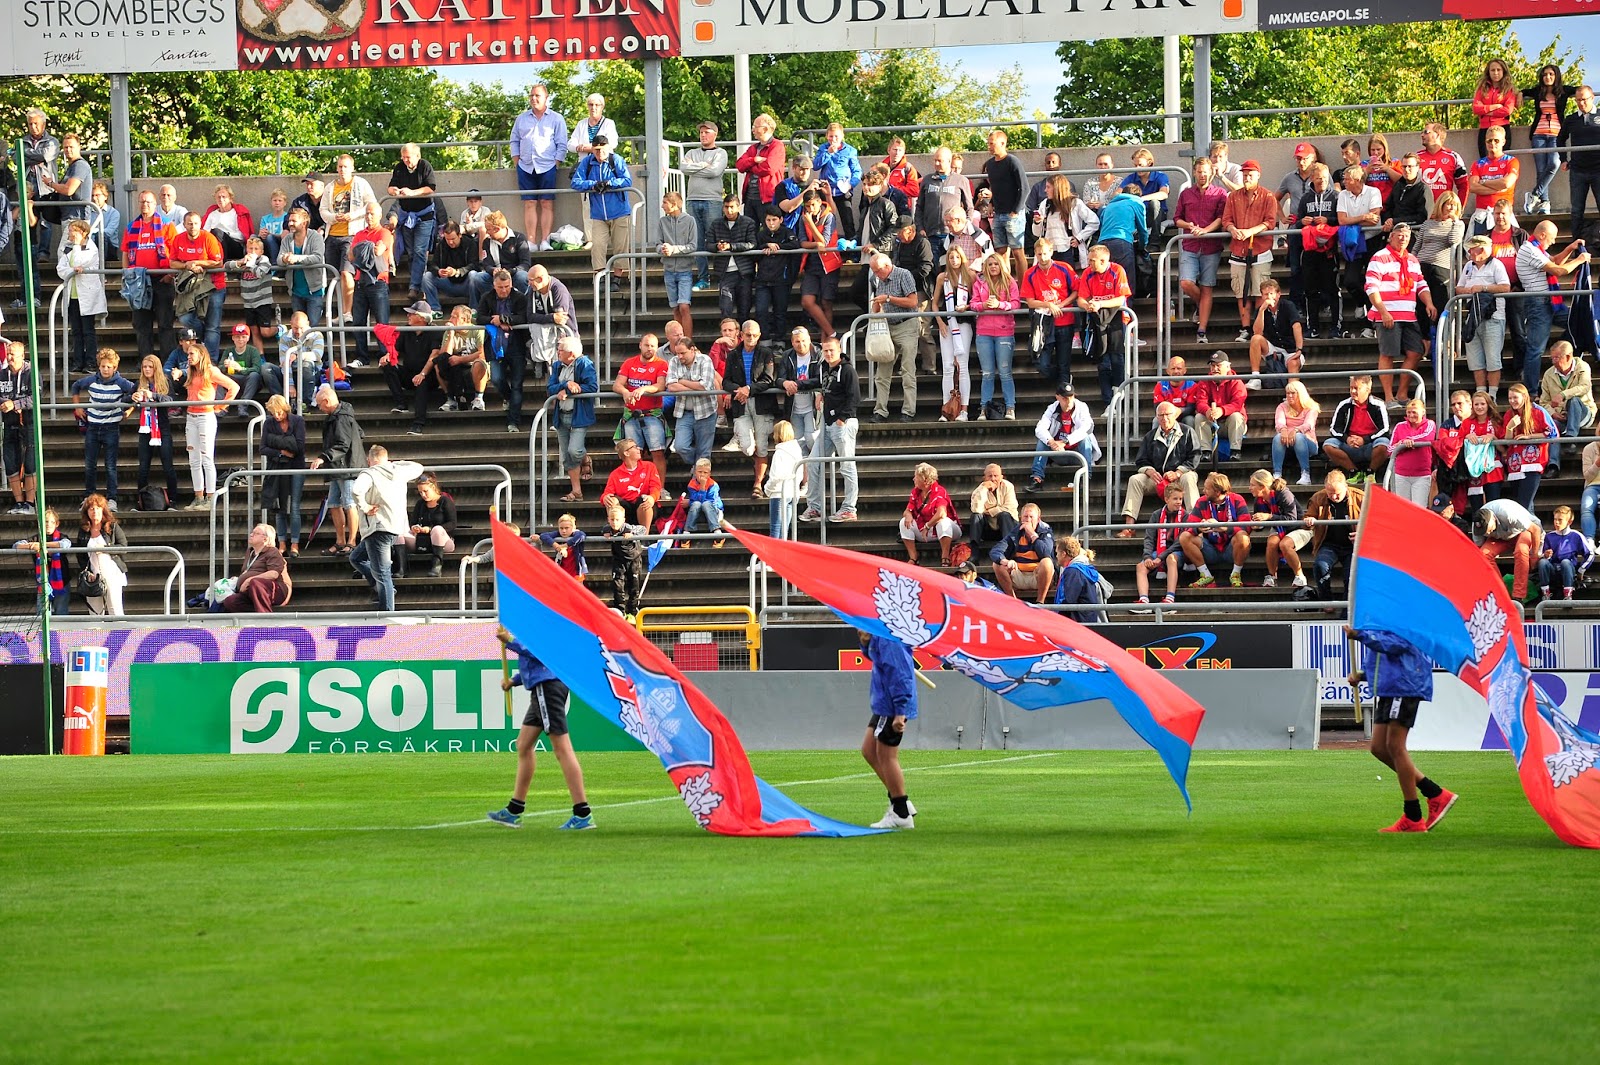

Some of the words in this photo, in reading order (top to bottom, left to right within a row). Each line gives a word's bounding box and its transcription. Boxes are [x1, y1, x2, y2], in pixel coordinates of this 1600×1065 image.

[1268, 8, 1370, 25] MIXMEGAPOL.SE
[43, 27, 206, 38] HANDELSDEPÅ
[243, 33, 670, 63] www.teaterkatten.com
